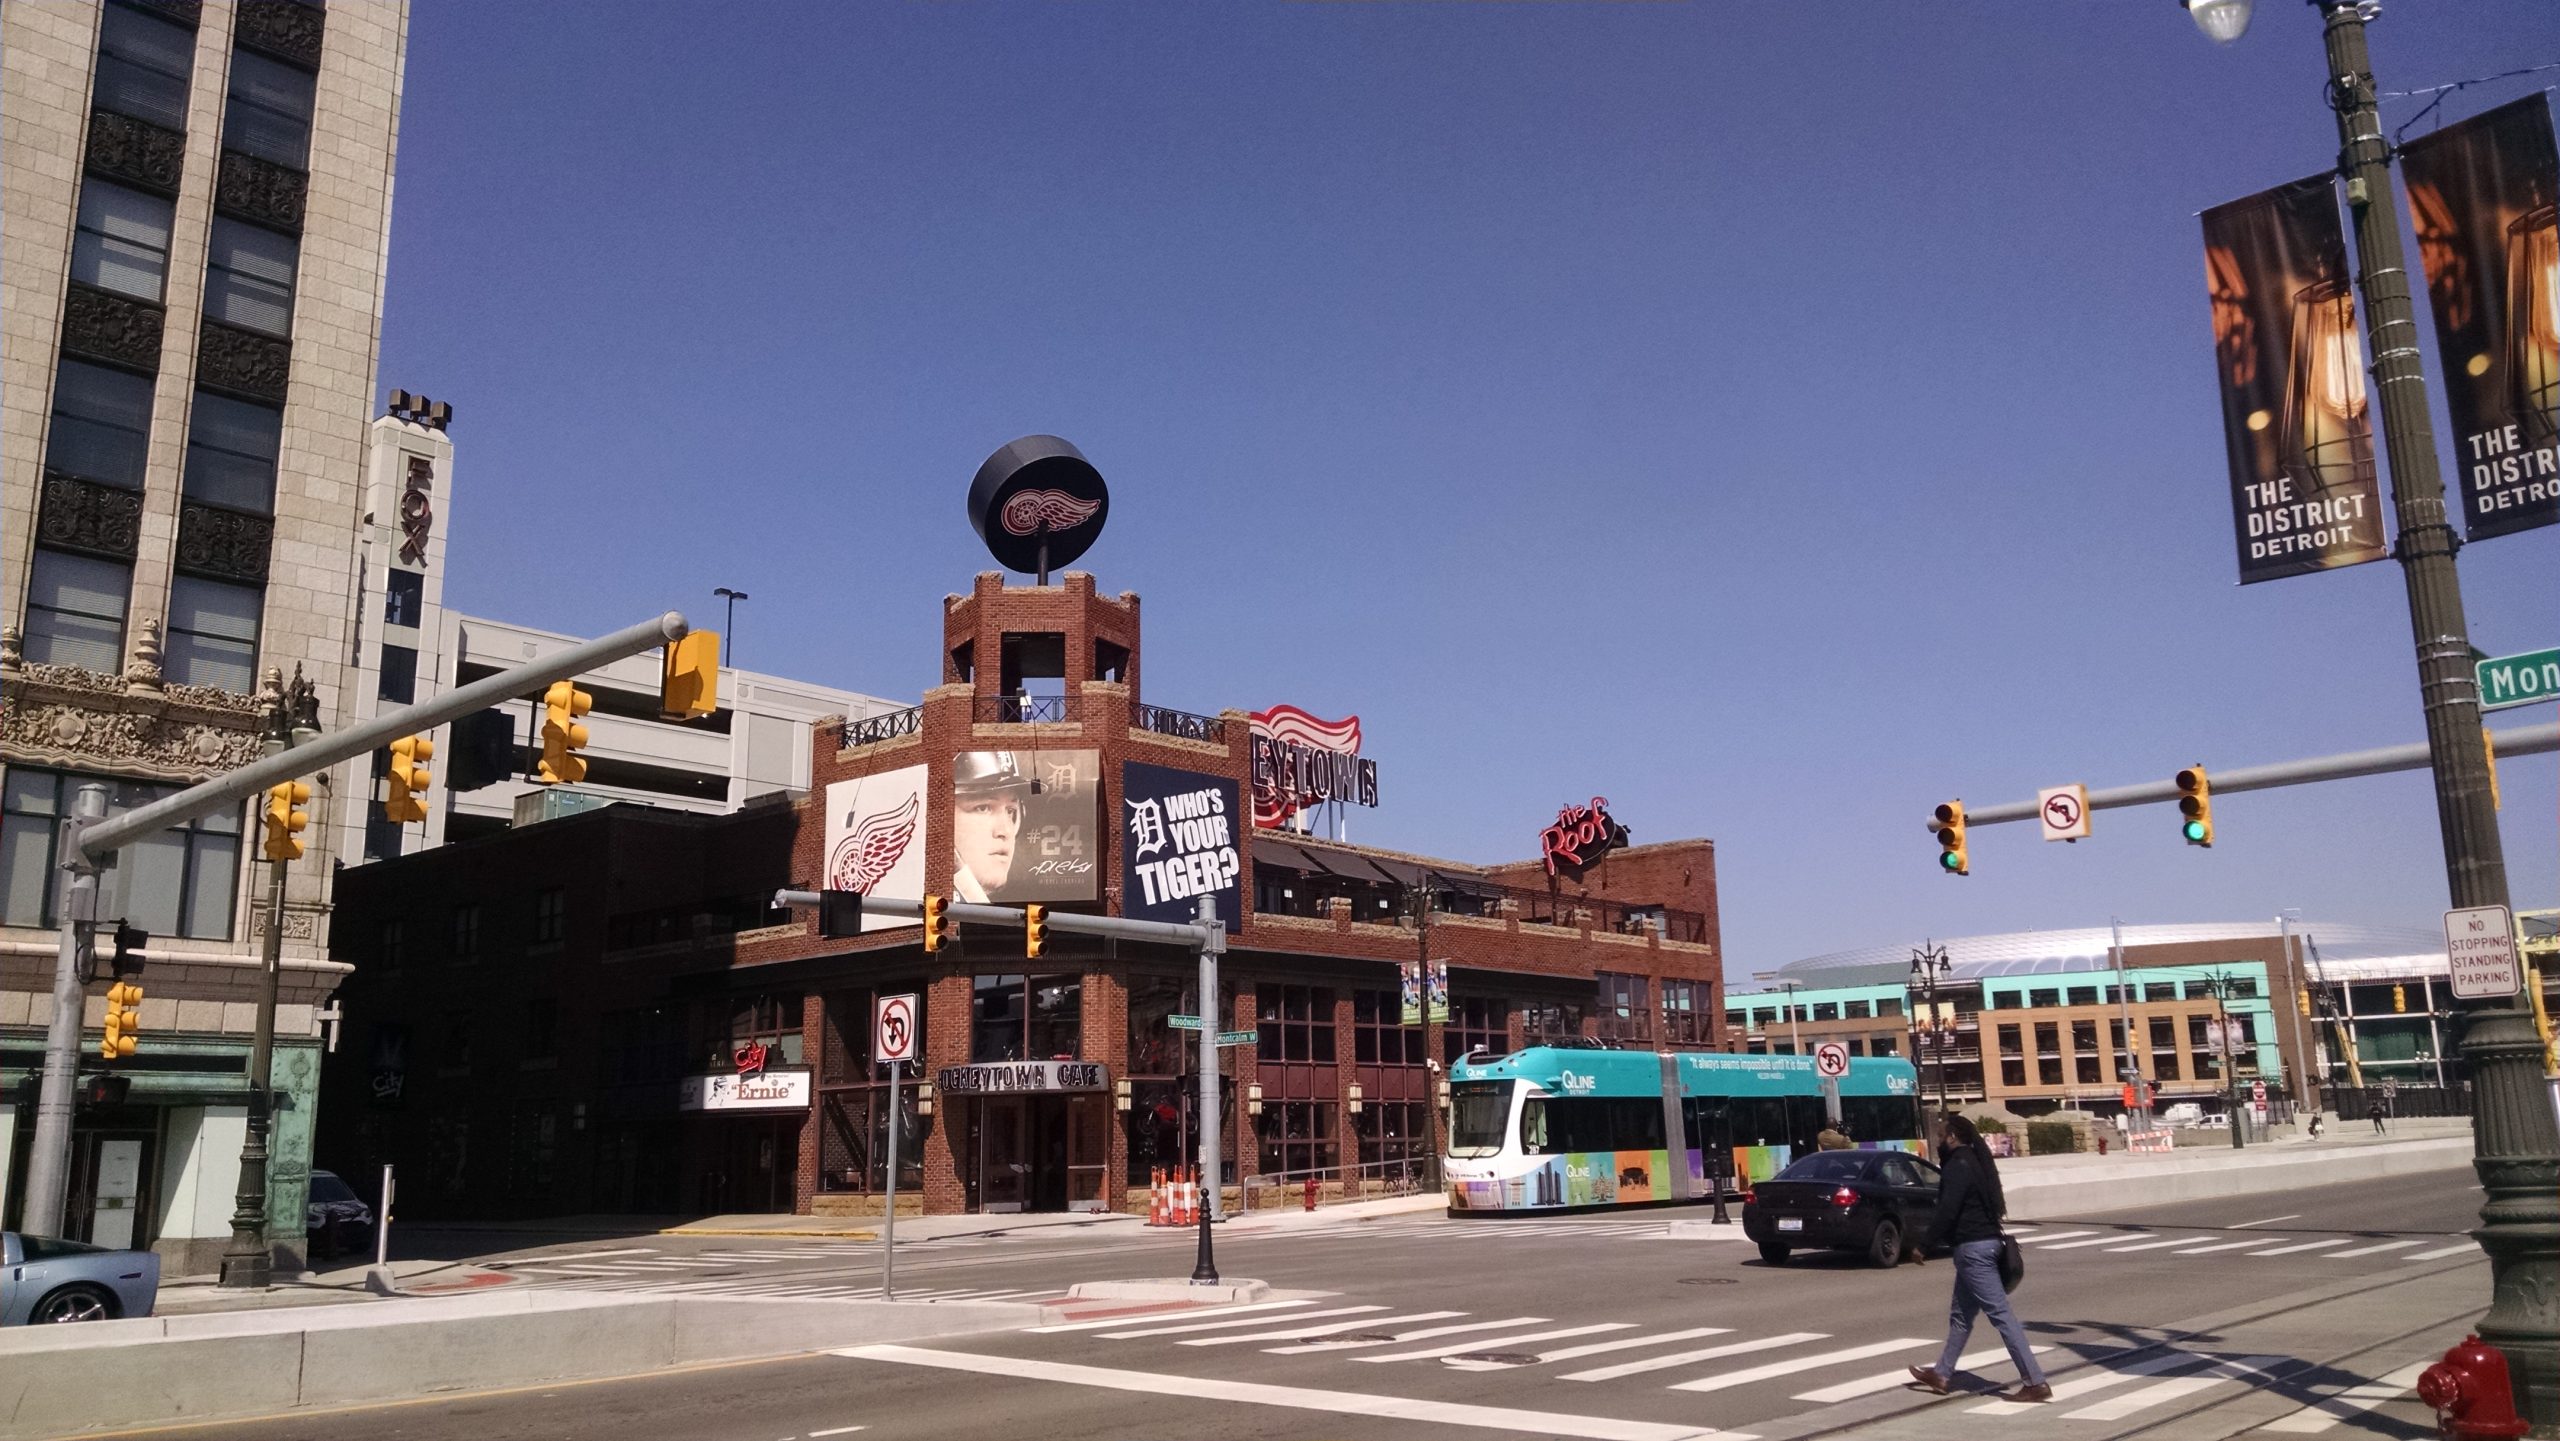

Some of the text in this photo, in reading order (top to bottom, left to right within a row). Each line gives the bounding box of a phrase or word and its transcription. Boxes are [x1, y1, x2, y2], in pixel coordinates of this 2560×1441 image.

[2468, 424, 2521, 459] THE
[2244, 477, 2293, 508] THE
[399, 455, 431, 562] FOX
[2248, 493, 2365, 537] DISTRICT
[2251, 526, 2352, 559] DETROIT
[2491, 663, 2560, 697] Mon
[1251, 733, 1378, 808] EYTOWN
[1163, 788, 1224, 821] WHO'S
[1027, 825, 1082, 855] #24
[1168, 815, 1231, 854] YOUR
[1539, 796, 1608, 875] Roof
[1135, 846, 1240, 905] TIGER?
[2469, 920, 2485, 931] NO
[2451, 936, 2508, 951] STOPPING
[2454, 953, 2511, 968] STANDING
[2460, 971, 2510, 985] PARKING
[1170, 1017, 1202, 1027] Woodward
[1217, 1033, 1256, 1043] Montcalm W
[1057, 1064, 1099, 1086] CAFE
[1562, 1070, 1595, 1089] QLINE
[1566, 1164, 1590, 1178] QLINE
